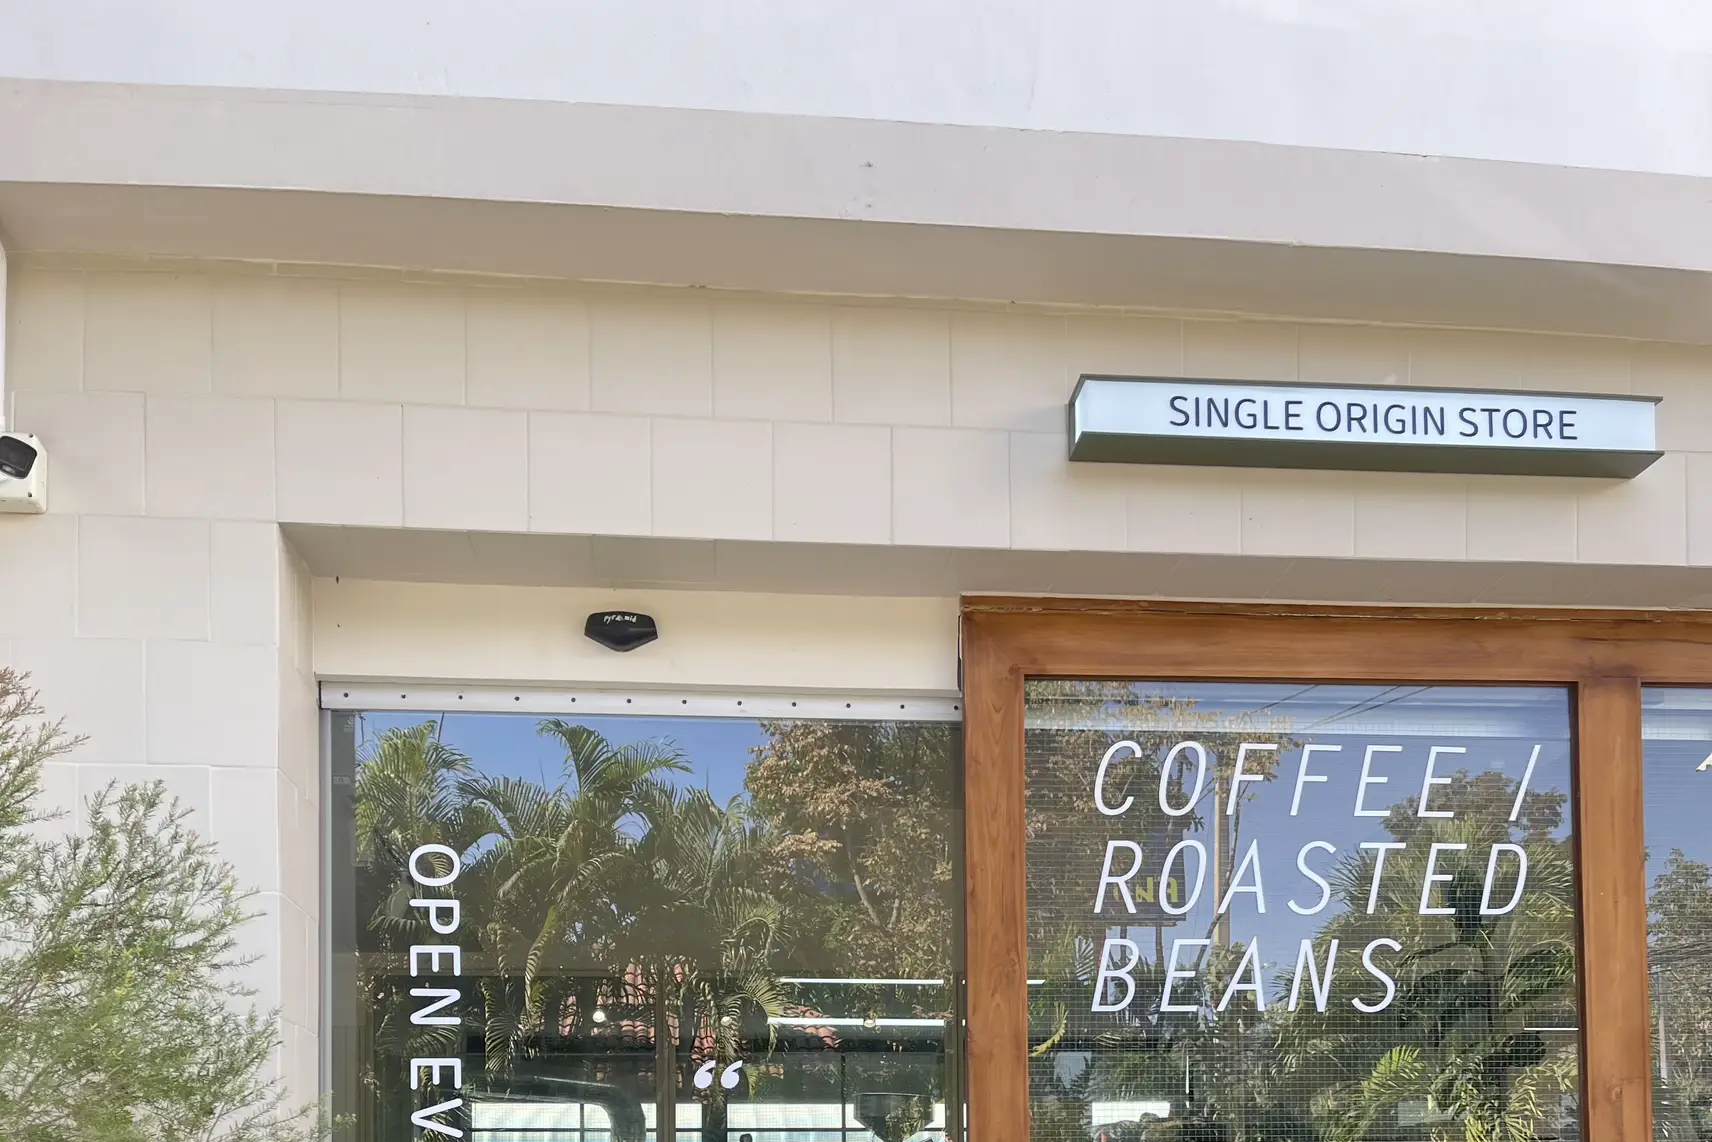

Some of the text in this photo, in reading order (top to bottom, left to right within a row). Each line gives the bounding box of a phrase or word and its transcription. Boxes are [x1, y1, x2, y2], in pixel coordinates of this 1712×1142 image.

[1168, 395, 1579, 441] SINGLE ORIGIN STORE
[1093, 839, 1530, 916] ROASTED
[408, 843, 461, 1025] OPEN
[1091, 936, 1403, 1014] BEANS
